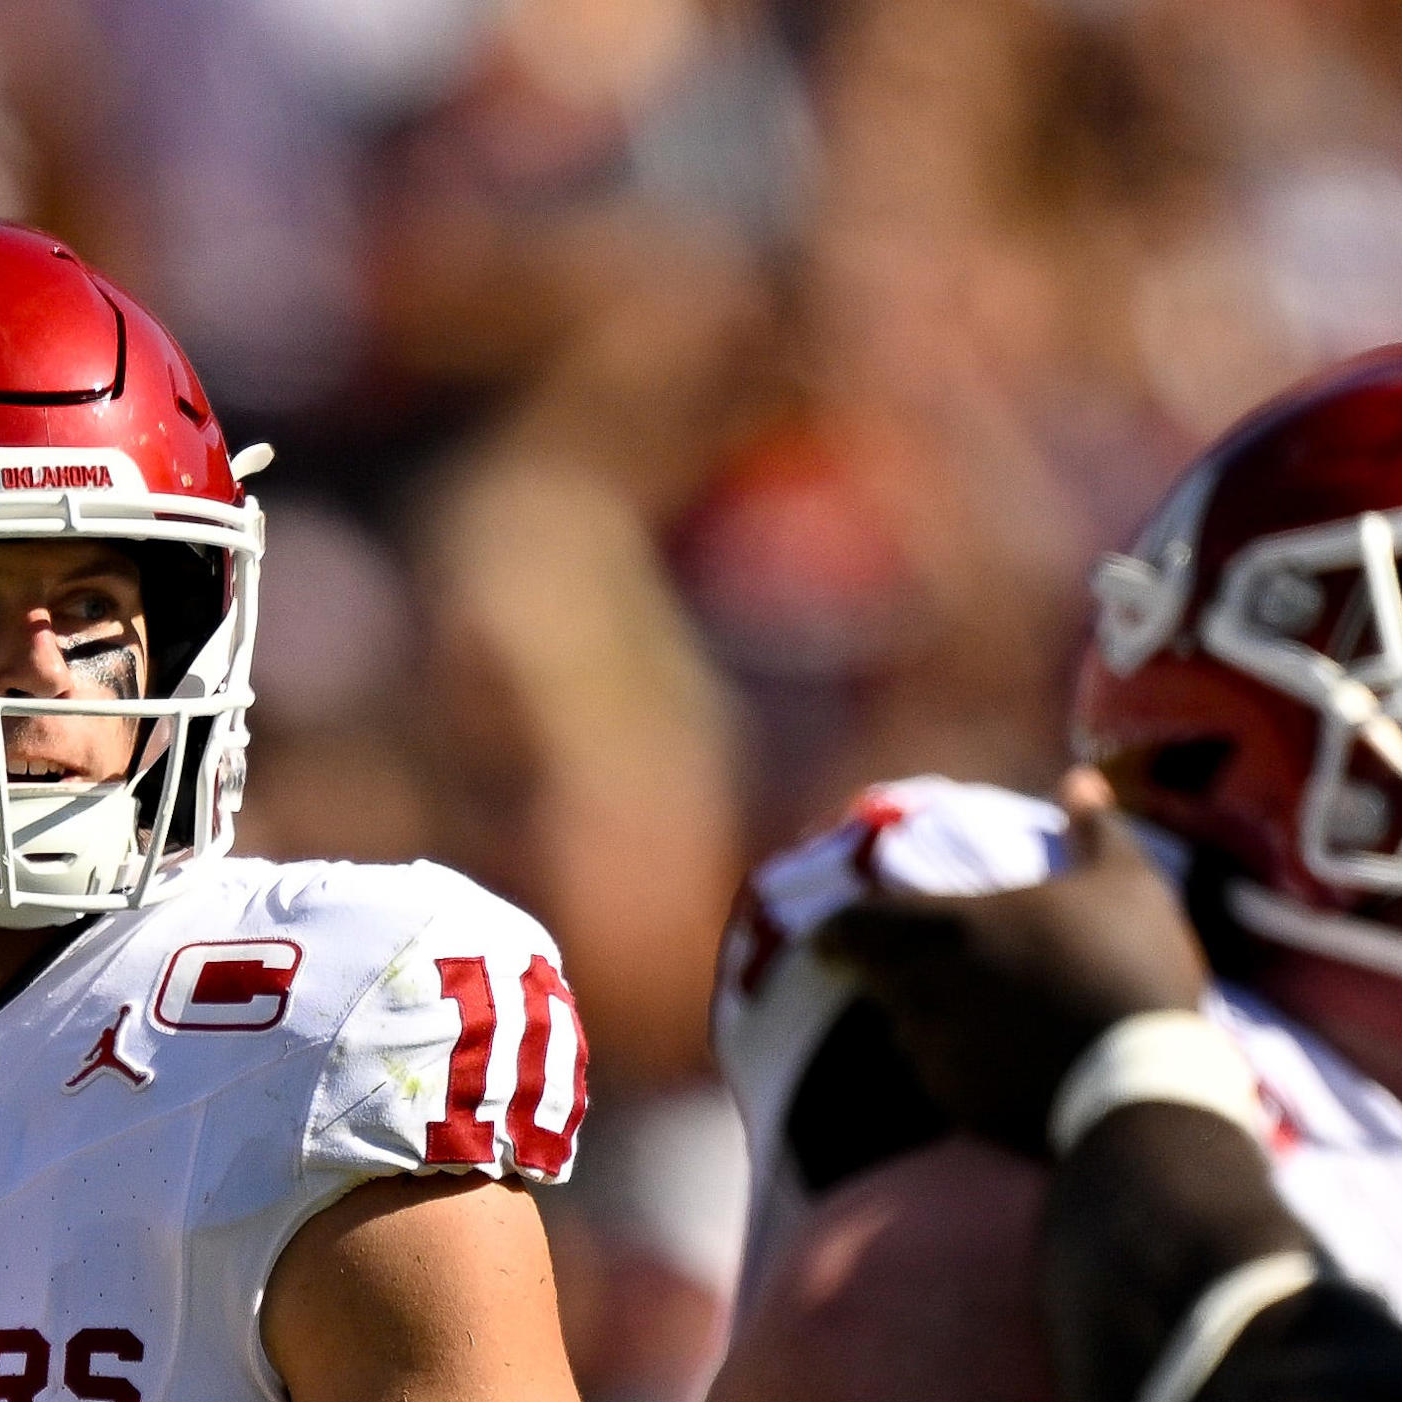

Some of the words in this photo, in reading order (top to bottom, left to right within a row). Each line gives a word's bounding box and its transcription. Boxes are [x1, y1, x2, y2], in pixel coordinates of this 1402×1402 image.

[0, 465, 114, 490] OKLAHOMA
[155, 938, 303, 1031] C
[426, 954, 589, 1178] 10
